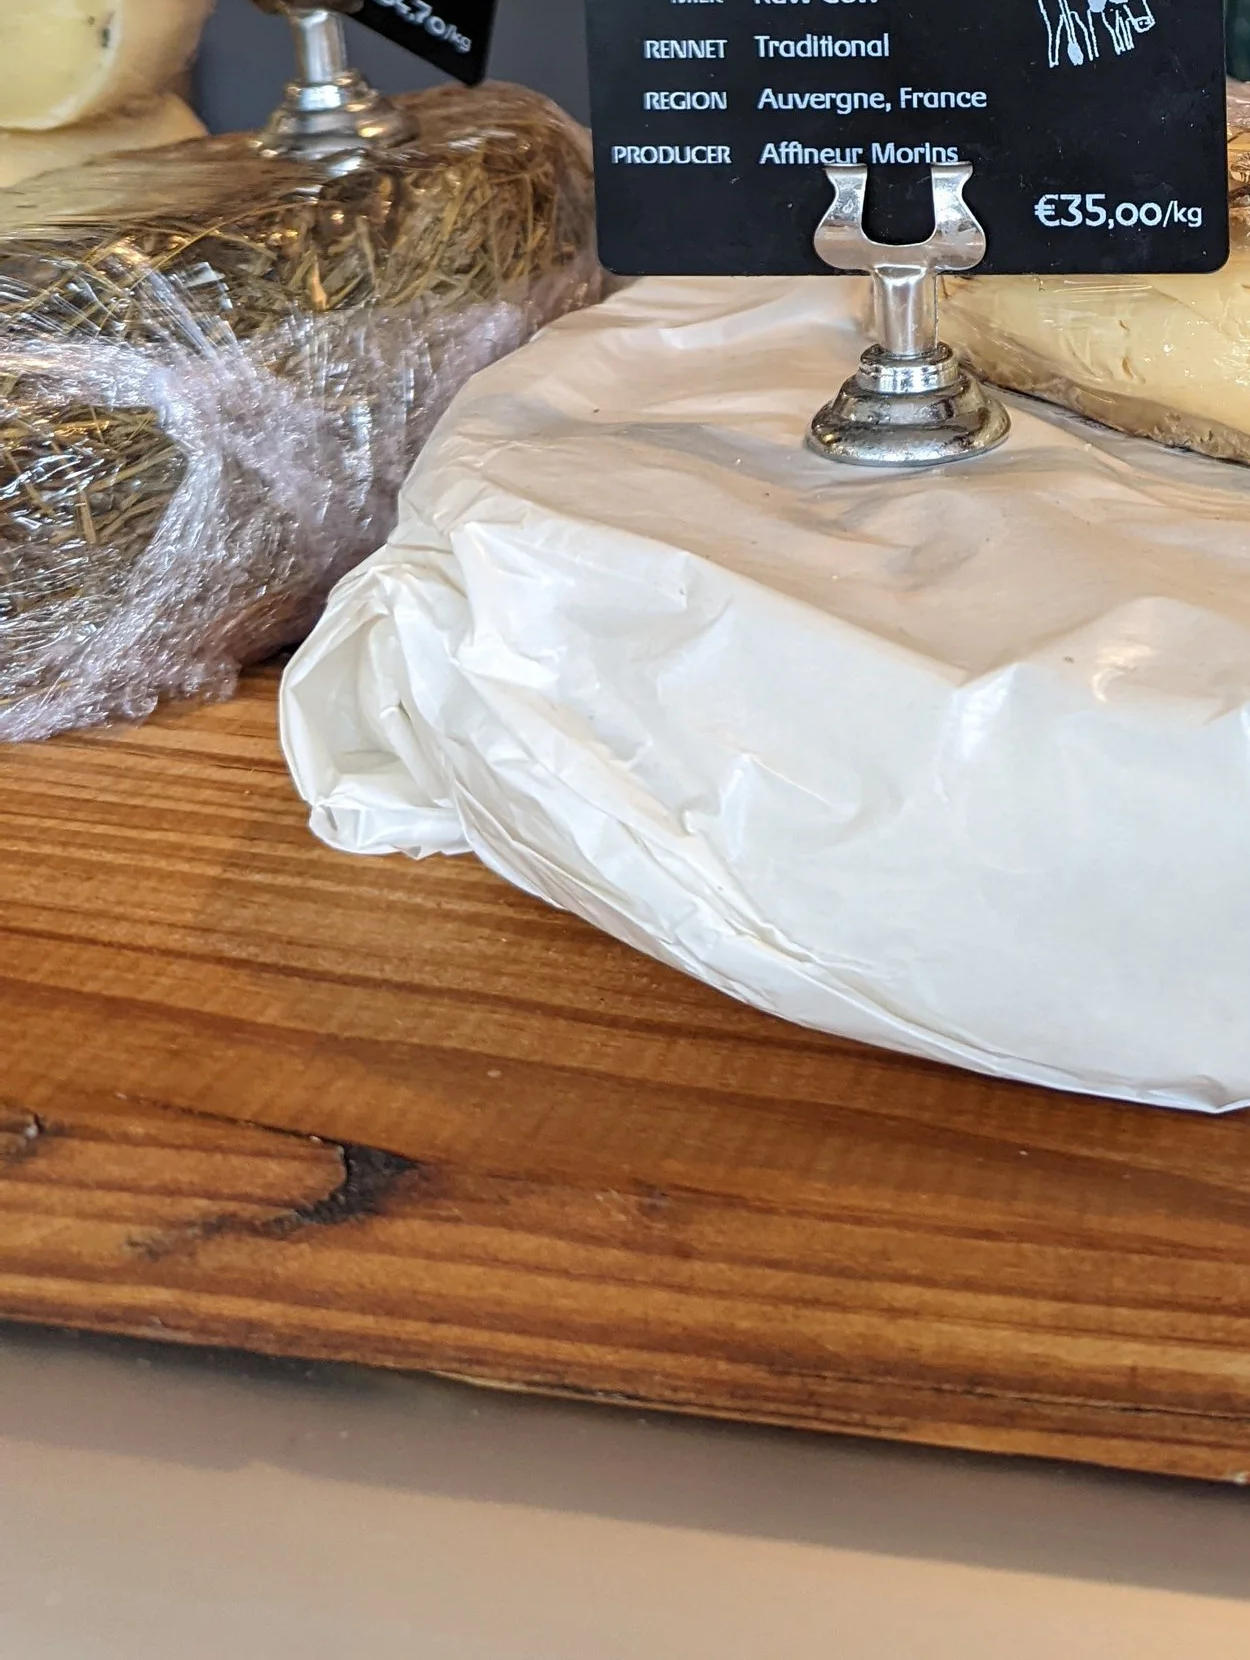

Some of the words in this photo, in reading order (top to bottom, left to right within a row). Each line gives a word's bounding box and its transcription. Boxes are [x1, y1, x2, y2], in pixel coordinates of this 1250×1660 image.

[645, 39, 727, 59] RENNET
[755, 35, 890, 58] Traditional
[644, 91, 727, 111] REGION
[758, 88, 892, 115] Auvergne,
[900, 87, 987, 110] France
[612, 144, 732, 165] PRODUCER
[759, 142, 863, 165] Affineur
[871, 142, 959, 164] Morins
[1033, 192, 1202, 230] €35,00/kg
